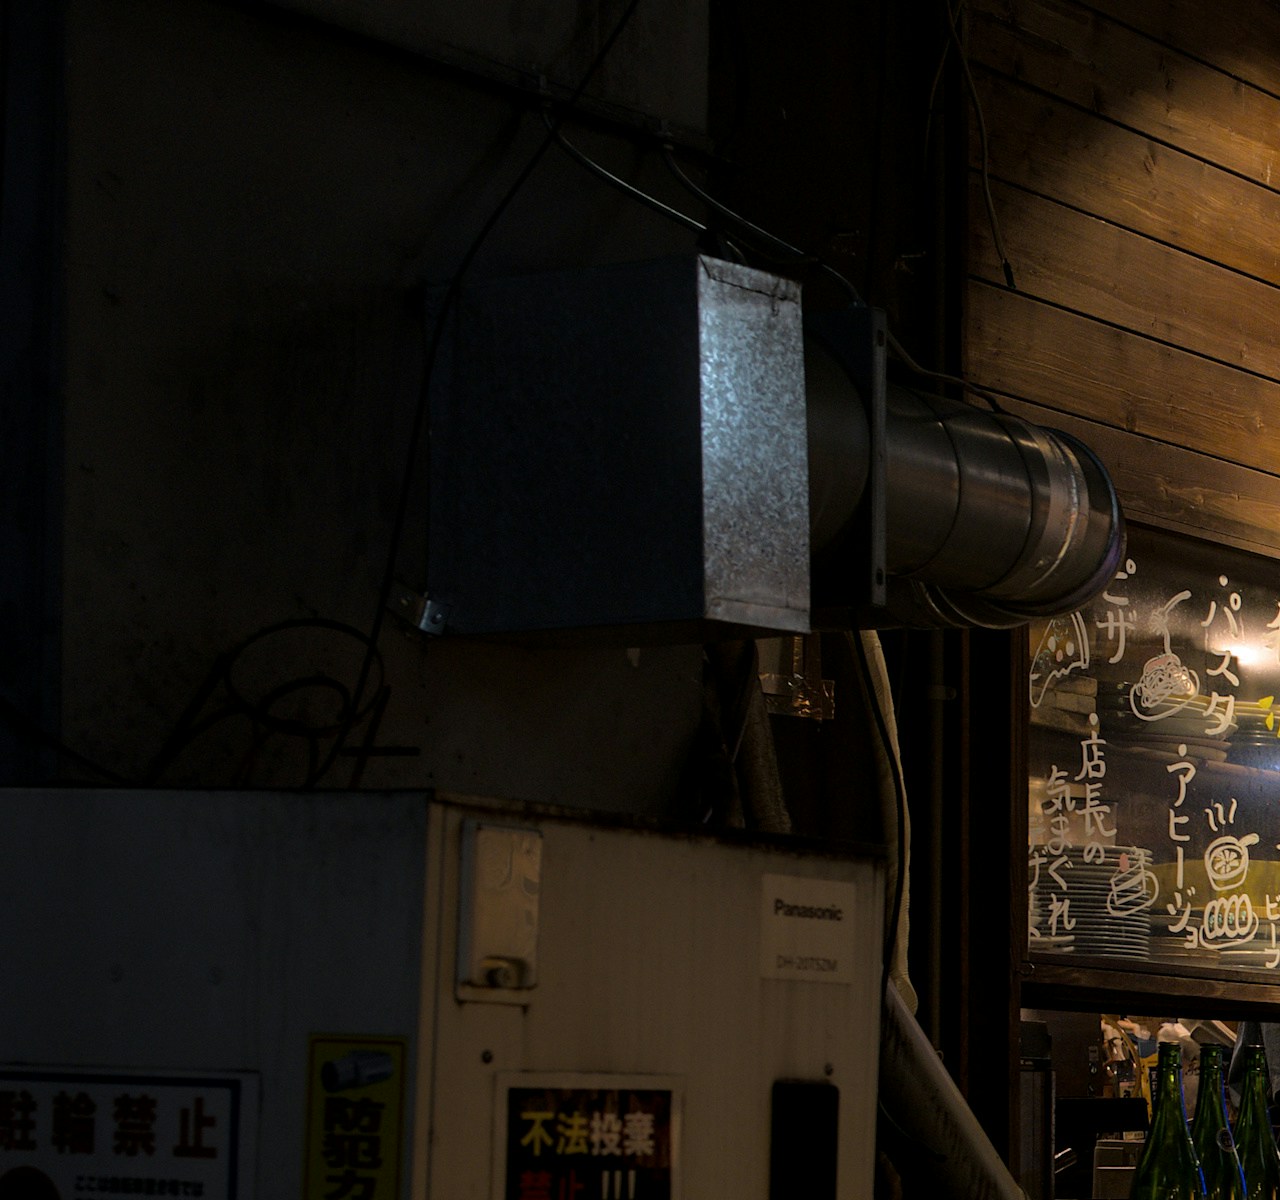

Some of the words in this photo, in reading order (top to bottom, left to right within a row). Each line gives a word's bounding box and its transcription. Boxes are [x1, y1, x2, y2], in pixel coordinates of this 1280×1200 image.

[1201, 591, 1243, 736] パスタ
[1074, 730, 1116, 865] 店長の
[1044, 765, 1077, 936] 気まぐれ
[774, 898, 843, 921] Panasonic
[0, 1091, 217, 1158] 駐輪禁止
[520, 1111, 656, 1157] 不法投棄
